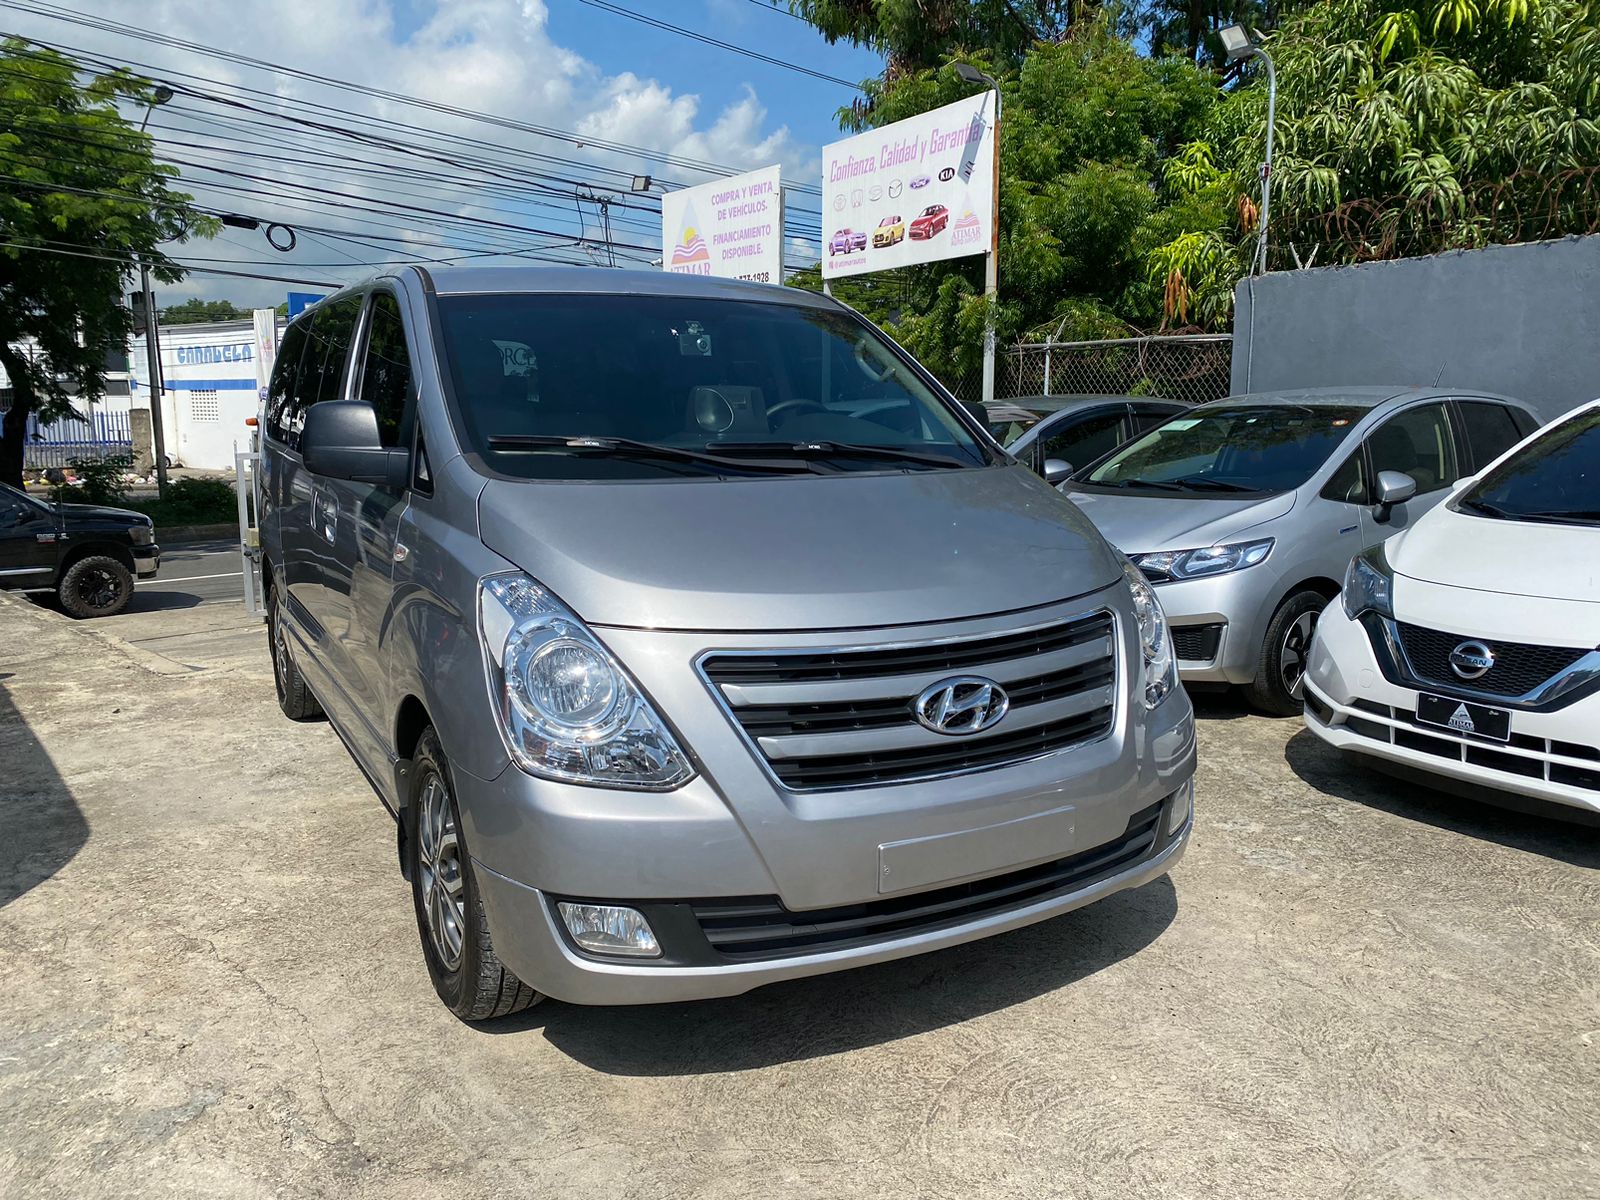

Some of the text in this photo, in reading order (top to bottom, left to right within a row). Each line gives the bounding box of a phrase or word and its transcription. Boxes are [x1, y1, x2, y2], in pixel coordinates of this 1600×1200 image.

[830, 155, 877, 183] Confianza,
[879, 135, 919, 170] Calidad
[920, 139, 928, 163] y
[940, 168, 954, 181] KIA
[711, 181, 773, 206] COMPRA Y VENTA
[717, 200, 768, 221] DE VEHÍCULOS.
[712, 224, 771, 246] FINANCIAMIENTO
[722, 243, 763, 260] DISPONIBLE.
